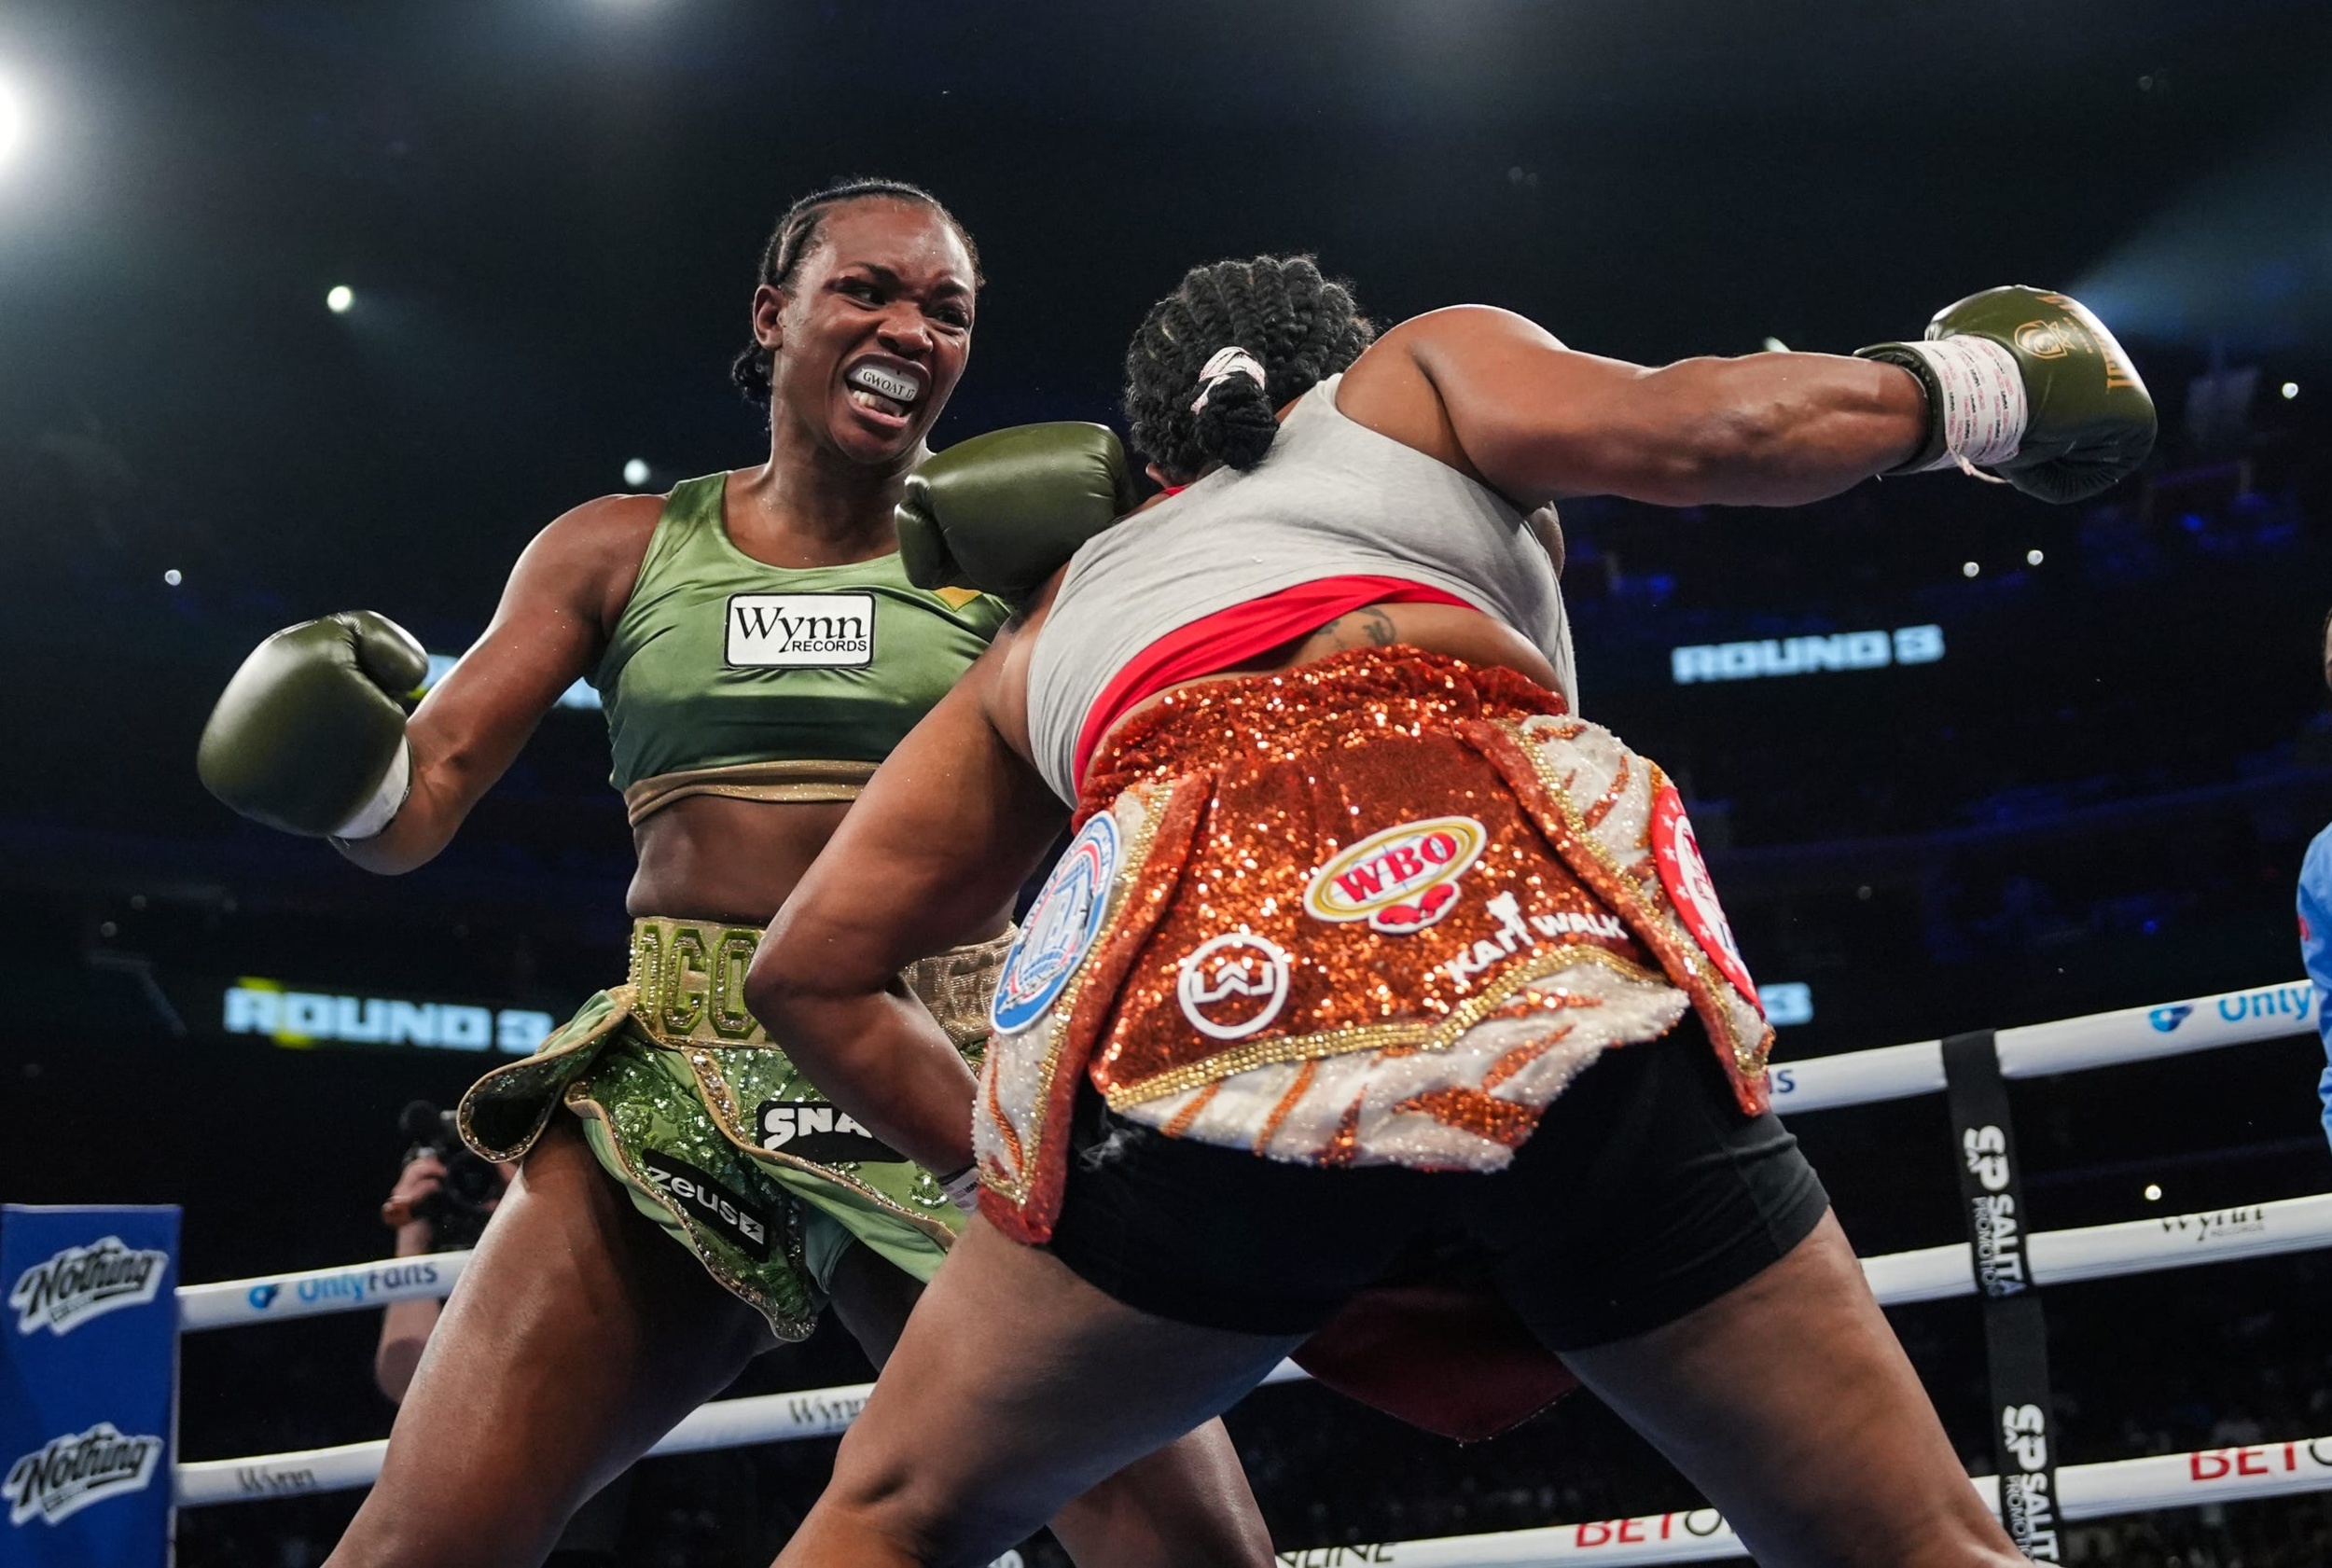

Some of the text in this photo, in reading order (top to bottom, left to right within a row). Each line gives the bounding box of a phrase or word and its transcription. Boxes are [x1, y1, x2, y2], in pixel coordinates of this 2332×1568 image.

[863, 371, 906, 395] GWOAT
[734, 606, 868, 654] Wynn
[792, 640, 868, 652] RECORDS
[1671, 624, 1946, 685] ROUND 3
[1331, 831, 1458, 903] WBO
[223, 986, 554, 1056] ROUND 3
[647, 1165, 739, 1226] zeus
[1973, 1197, 2004, 1297] PROMOTIO
[1988, 1194, 2027, 1297] SALITA
[20, 1245, 154, 1318] Nothing
[11, 1430, 148, 1507] Nothing
